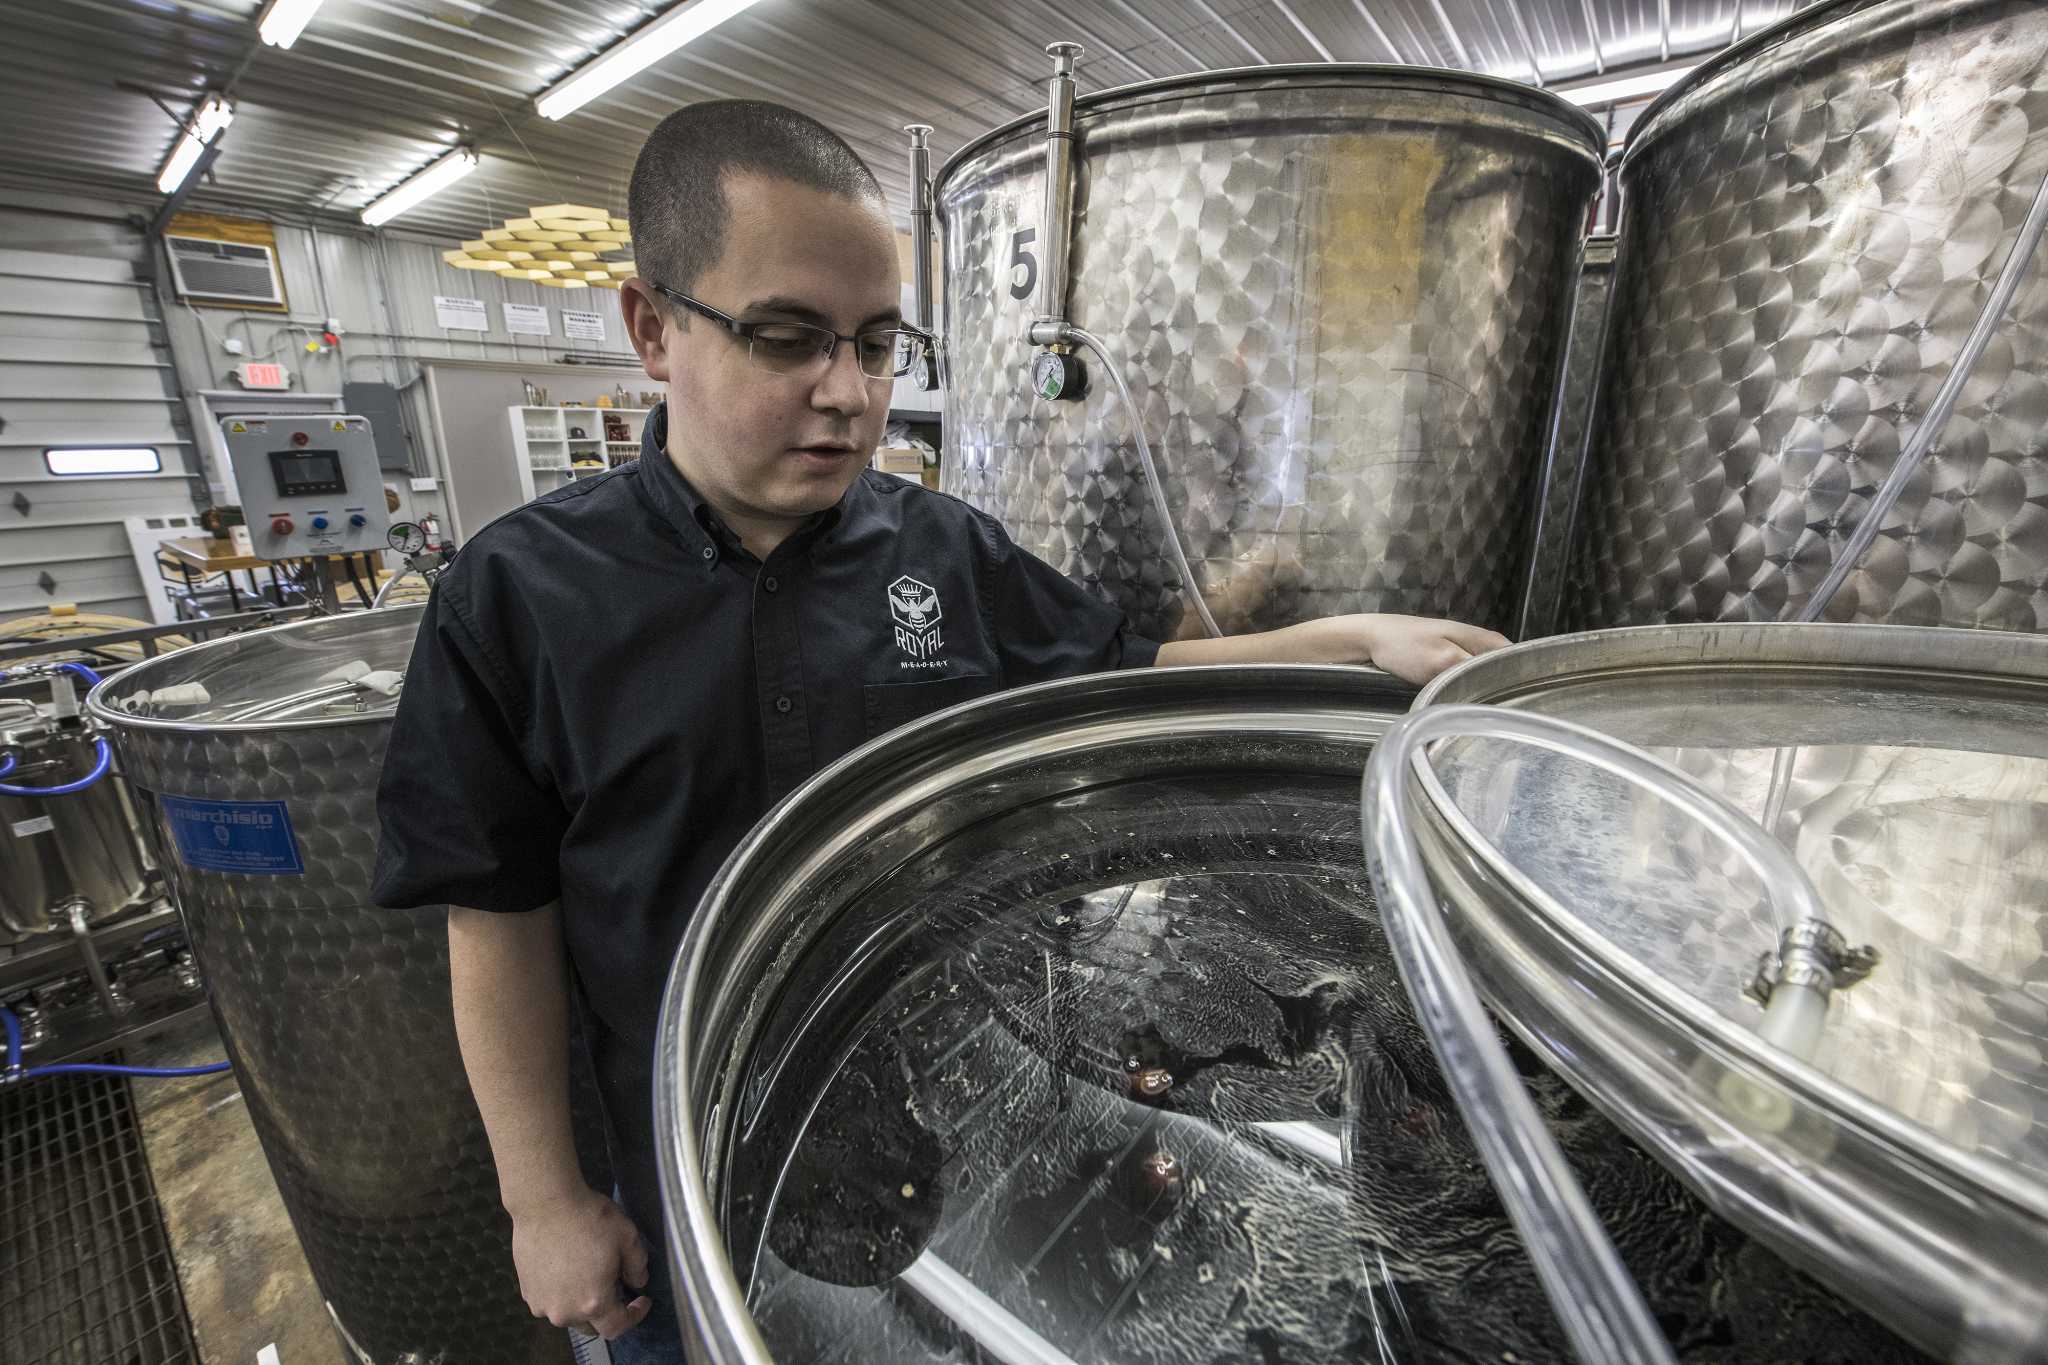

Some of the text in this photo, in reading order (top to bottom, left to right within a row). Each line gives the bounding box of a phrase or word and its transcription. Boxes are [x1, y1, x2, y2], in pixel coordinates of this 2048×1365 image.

[1010, 227, 1037, 300] 5
[248, 364, 281, 385] EXIT
[894, 626, 945, 659] ROYAL
